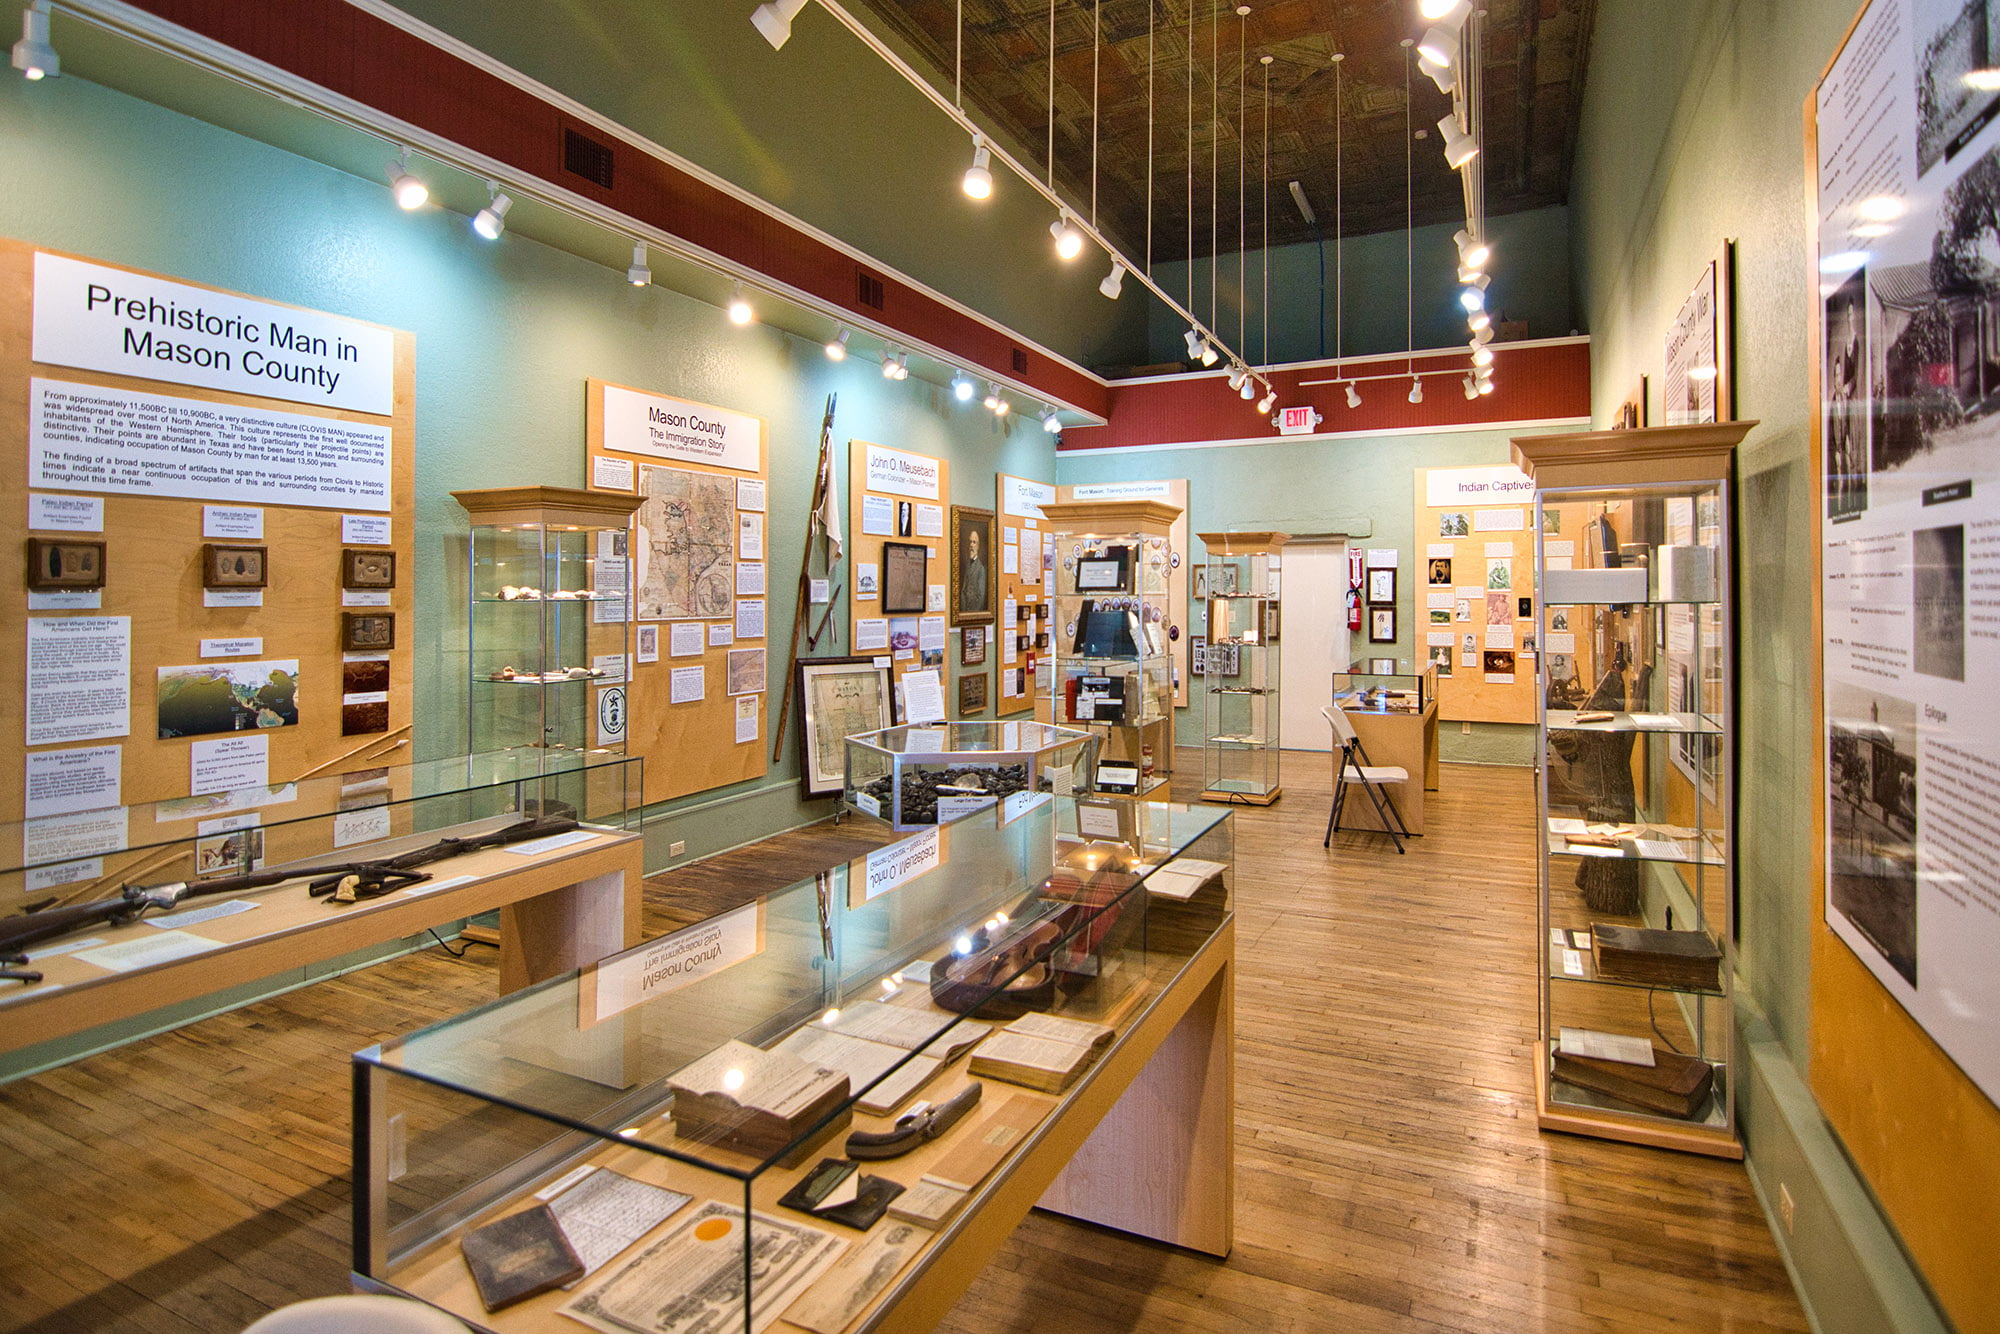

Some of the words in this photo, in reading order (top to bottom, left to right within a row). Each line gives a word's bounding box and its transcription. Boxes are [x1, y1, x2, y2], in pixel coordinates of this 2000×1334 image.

[87, 284, 260, 343] Prehistoric
[269, 321, 328, 358] Man
[337, 337, 358, 363] in
[123, 327, 232, 372] Mason
[242, 351, 341, 394] County
[43, 402, 62, 410] was
[64, 403, 114, 418] widespread
[116, 411, 136, 419] over
[138, 412, 158, 422] most
[160, 415, 169, 423] of
[171, 416, 193, 426] North
[229, 423, 245, 432] This
[247, 426, 271, 435] culture
[272, 429, 307, 441] represents
[309, 433, 320, 441] the
[321, 435, 334, 443] first
[335, 437, 348, 445] well
[349, 438, 384, 449] documented
[44, 390, 66, 401] From
[69, 393, 127, 410] approximately
[225, 416, 239, 424] very
[241, 416, 274, 427] distinctive
[275, 421, 298, 430] culture
[299, 424, 326, 435] (CLOVIS
[327, 428, 345, 438] MAN)
[346, 430, 372, 441] appeared
[649, 407, 686, 428] Mason
[690, 416, 726, 438] County
[1286, 409, 1308, 427] EXIT
[42, 430, 83, 443] counties,
[84, 435, 125, 448] indicating
[126, 439, 170, 453] occupation
[170, 444, 179, 452] of
[180, 445, 206, 454] Mason
[206, 447, 233, 459] County
[233, 450, 243, 460] by
[260, 453, 270, 461] for
[271, 454, 279, 462] at
[279, 455, 296, 463] least
[43, 410, 92, 423] inhabitants
[96, 416, 106, 425] of
[110, 418, 124, 427] the
[128, 420, 162, 431] Western
[166, 425, 213, 439] Hemisphere.
[217, 431, 236, 440] Their
[240, 433, 257, 442] tools
[260, 436, 300, 449] (particularly
[303, 441, 318, 449] their
[351, 446, 372, 457] points)
[92, 426, 115, 436] Their
[117, 428, 143, 441] points
[161, 433, 197, 444] abundant
[198, 437, 206, 445] in
[208, 439, 230, 448] Texas
[232, 441, 246, 450] and
[247, 443, 265, 452] have
[266, 445, 284, 454] been
[285, 447, 305, 456] found
[306, 449, 313, 457] in
[314, 450, 336, 459] Mason
[337, 453, 349, 461] and
[350, 454, 384, 466] surrounding
[649, 427, 664, 439] The
[666, 430, 706, 446] Immigration
[708, 439, 725, 452] Story
[41, 471, 90, 484] throughout
[90, 474, 107, 483] this
[108, 476, 127, 485] time
[127, 477, 154, 487] frame.
[42, 451, 61, 460] The
[62, 452, 92, 465] finding
[94, 455, 104, 464] of
[114, 457, 138, 467] broad
[140, 459, 177, 472] spectrum
[178, 463, 187, 471] of
[188, 464, 218, 474] artifacts
[219, 467, 234, 475] that
[235, 470, 253, 478] span
[254, 470, 266, 478] the
[267, 471, 292, 480] various
[293, 473, 318, 484] periods
[318, 475, 334, 483] from
[334, 477, 354, 485] Clovis
[362, 479, 384, 488] Historic
[42, 461, 67, 471] times
[72, 463, 106, 474] indicate
[144, 469, 186, 480] continuous
[190, 473, 231, 485] occupation
[245, 477, 258, 485] this
[262, 479, 275, 487] and
[278, 480, 317, 492] surrounding
[320, 484, 346, 492] counties
[348, 486, 357, 495] by
[871, 454, 888, 469] John
[900, 460, 935, 478] Meusebach
[1459, 482, 1488, 492] Indian
